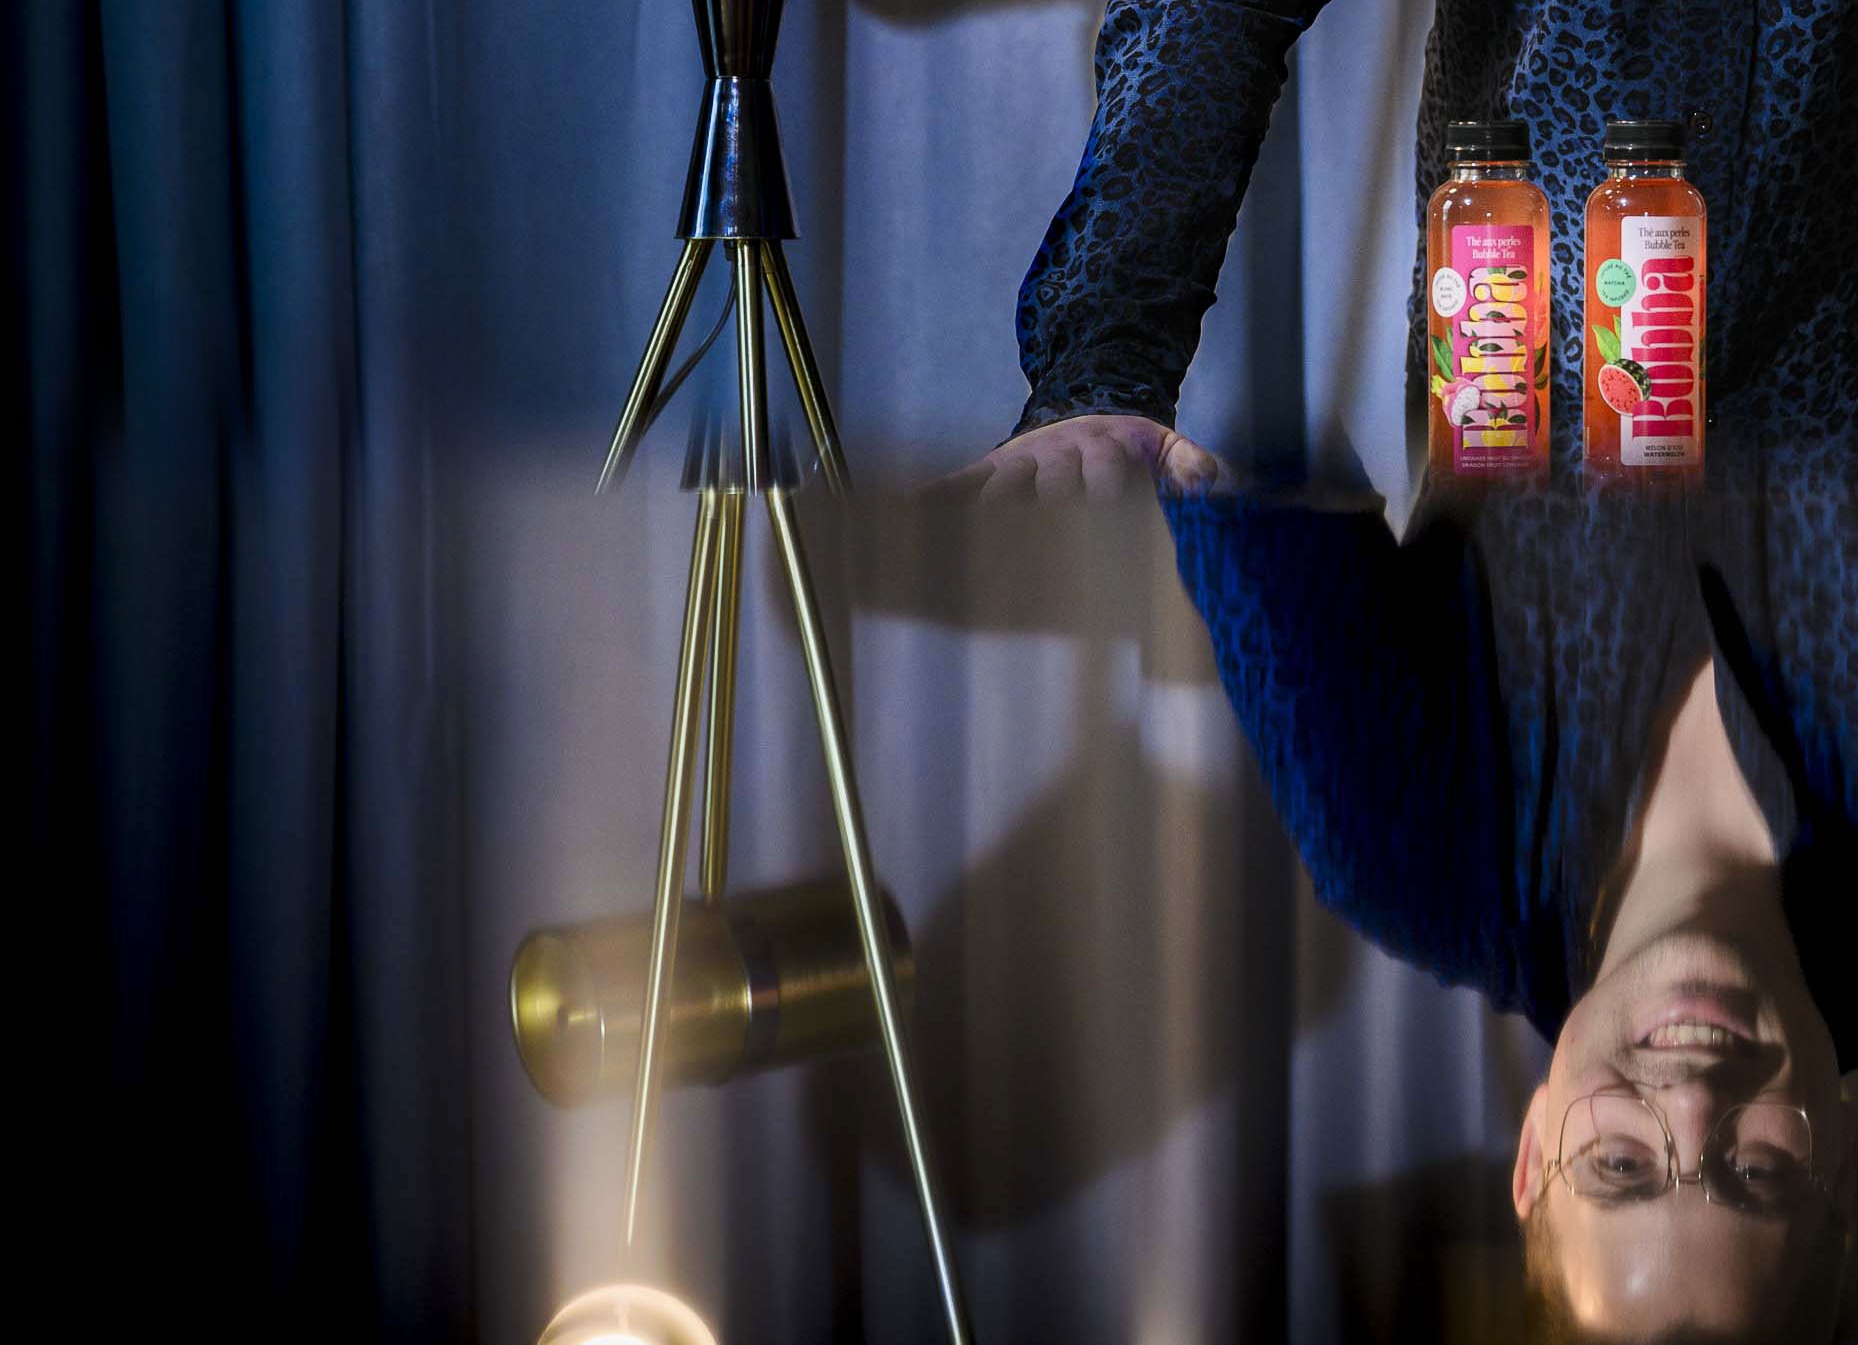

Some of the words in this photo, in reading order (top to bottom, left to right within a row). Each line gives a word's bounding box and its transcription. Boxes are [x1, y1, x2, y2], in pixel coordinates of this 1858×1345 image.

[1638, 227, 1655, 238] Thé
[1655, 229, 1669, 238] aux
[1670, 227, 1690, 239] perles
[1466, 235, 1481, 247] Thé
[1498, 235, 1521, 249] perles
[1644, 240, 1672, 250] Bubble
[1673, 240, 1686, 250] Tea
[1472, 248, 1501, 259] Bubble
[1502, 249, 1516, 259] Tea
[1631, 256, 1694, 438] Bobba
